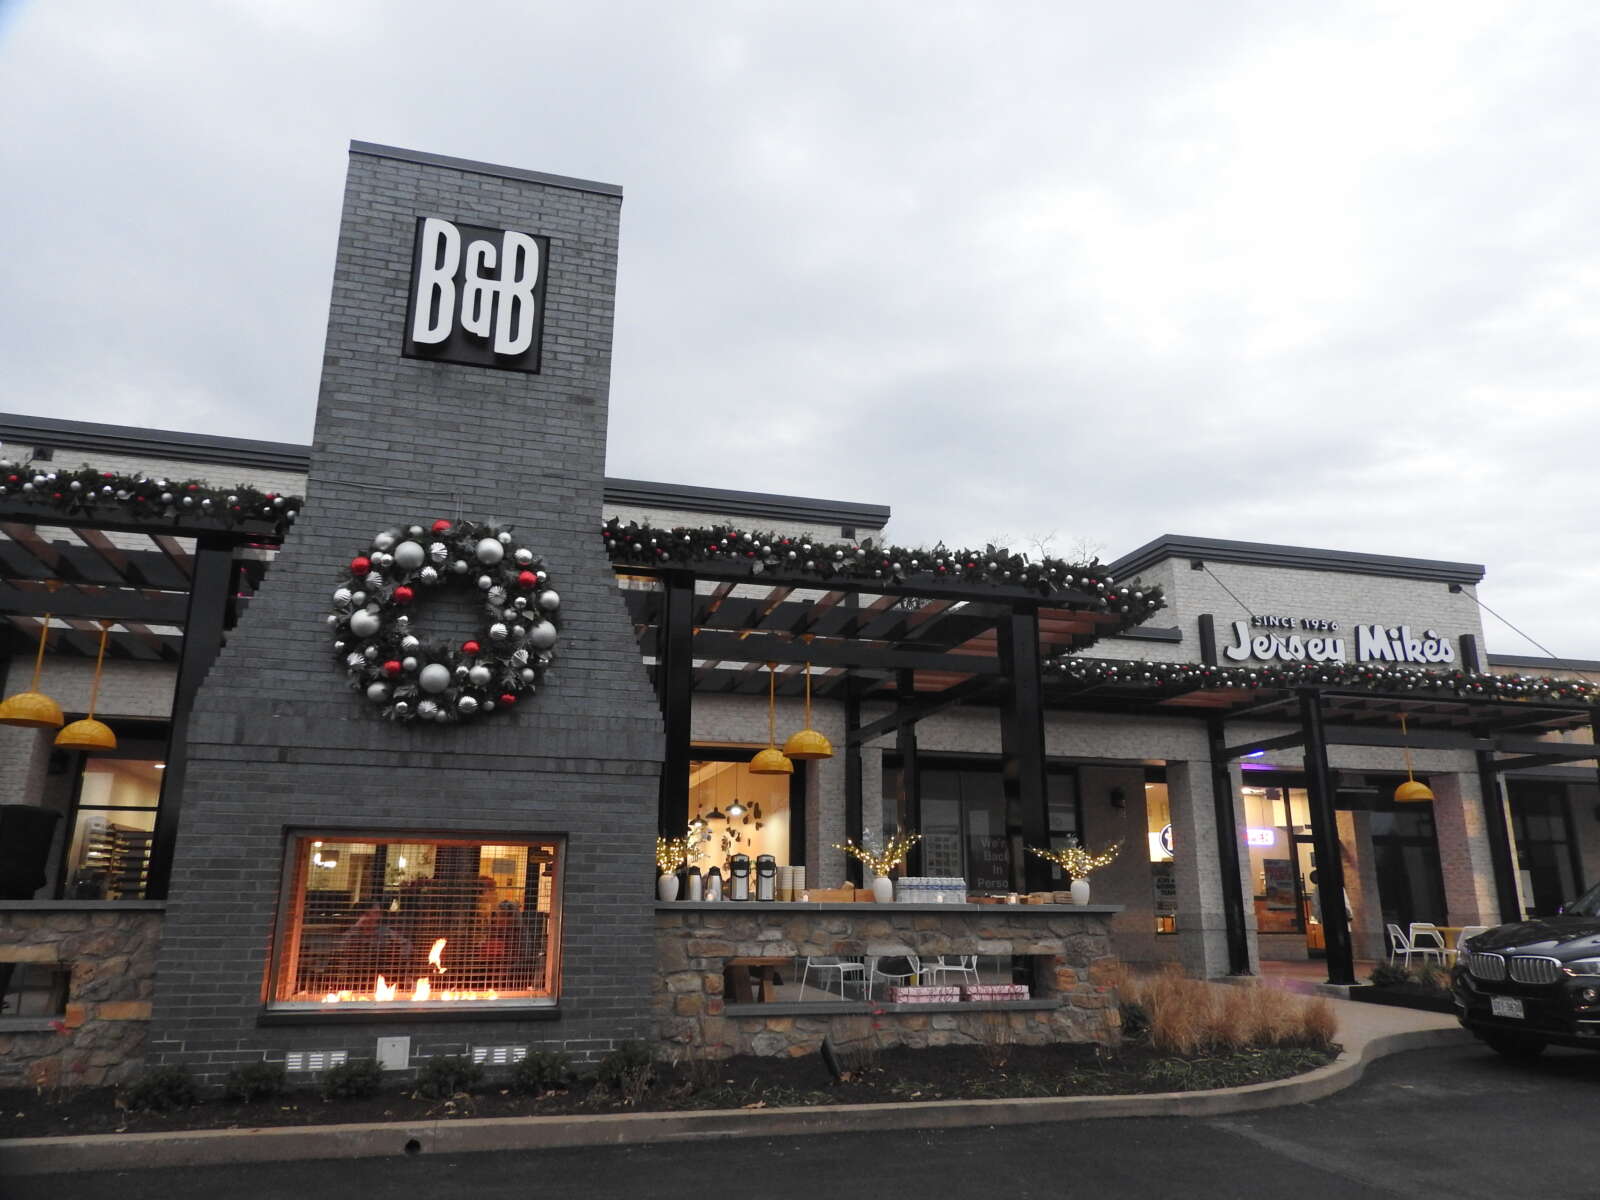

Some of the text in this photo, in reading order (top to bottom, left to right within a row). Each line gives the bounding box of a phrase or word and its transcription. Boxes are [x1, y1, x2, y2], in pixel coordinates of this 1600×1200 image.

[413, 217, 540, 356] B&B
[1253, 615, 1338, 631] SINCE 1956
[1225, 621, 1345, 664] Jersey
[980, 837, 1008, 848] We'r
[977, 877, 1008, 888] Perso
